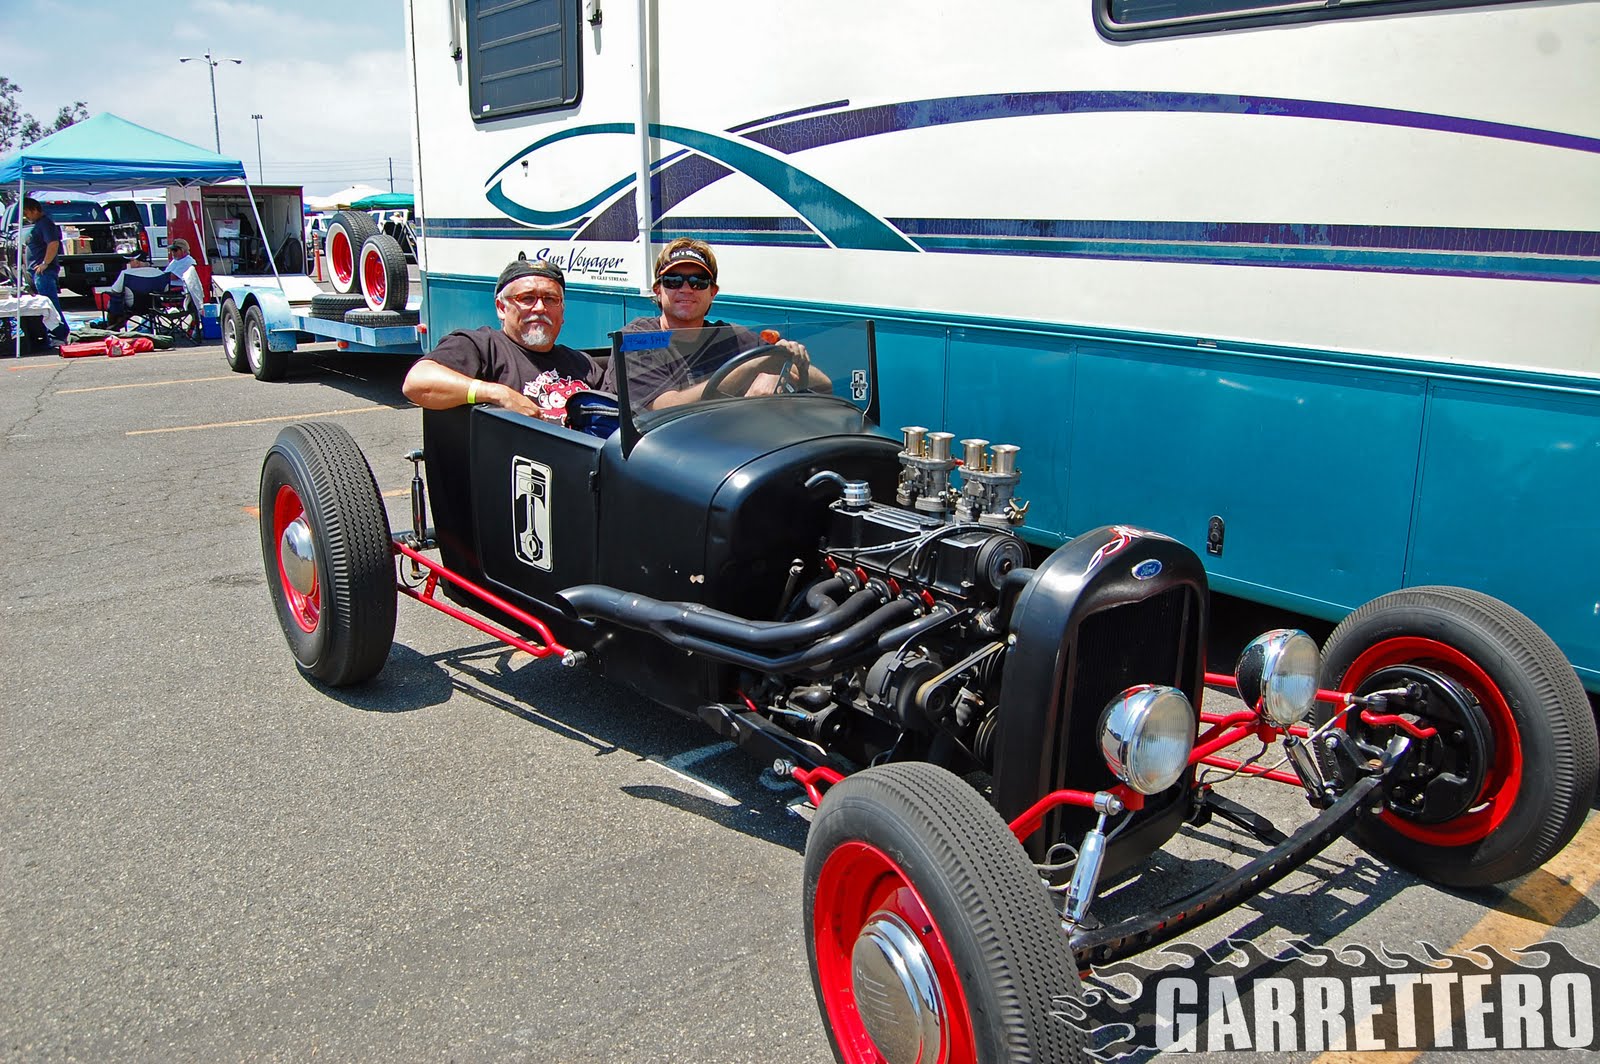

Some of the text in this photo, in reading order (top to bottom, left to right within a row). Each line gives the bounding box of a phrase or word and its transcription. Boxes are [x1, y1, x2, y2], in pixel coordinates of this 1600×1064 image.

[536, 247, 624, 275] Sun Voyager
[1140, 564, 1157, 576] Ford
